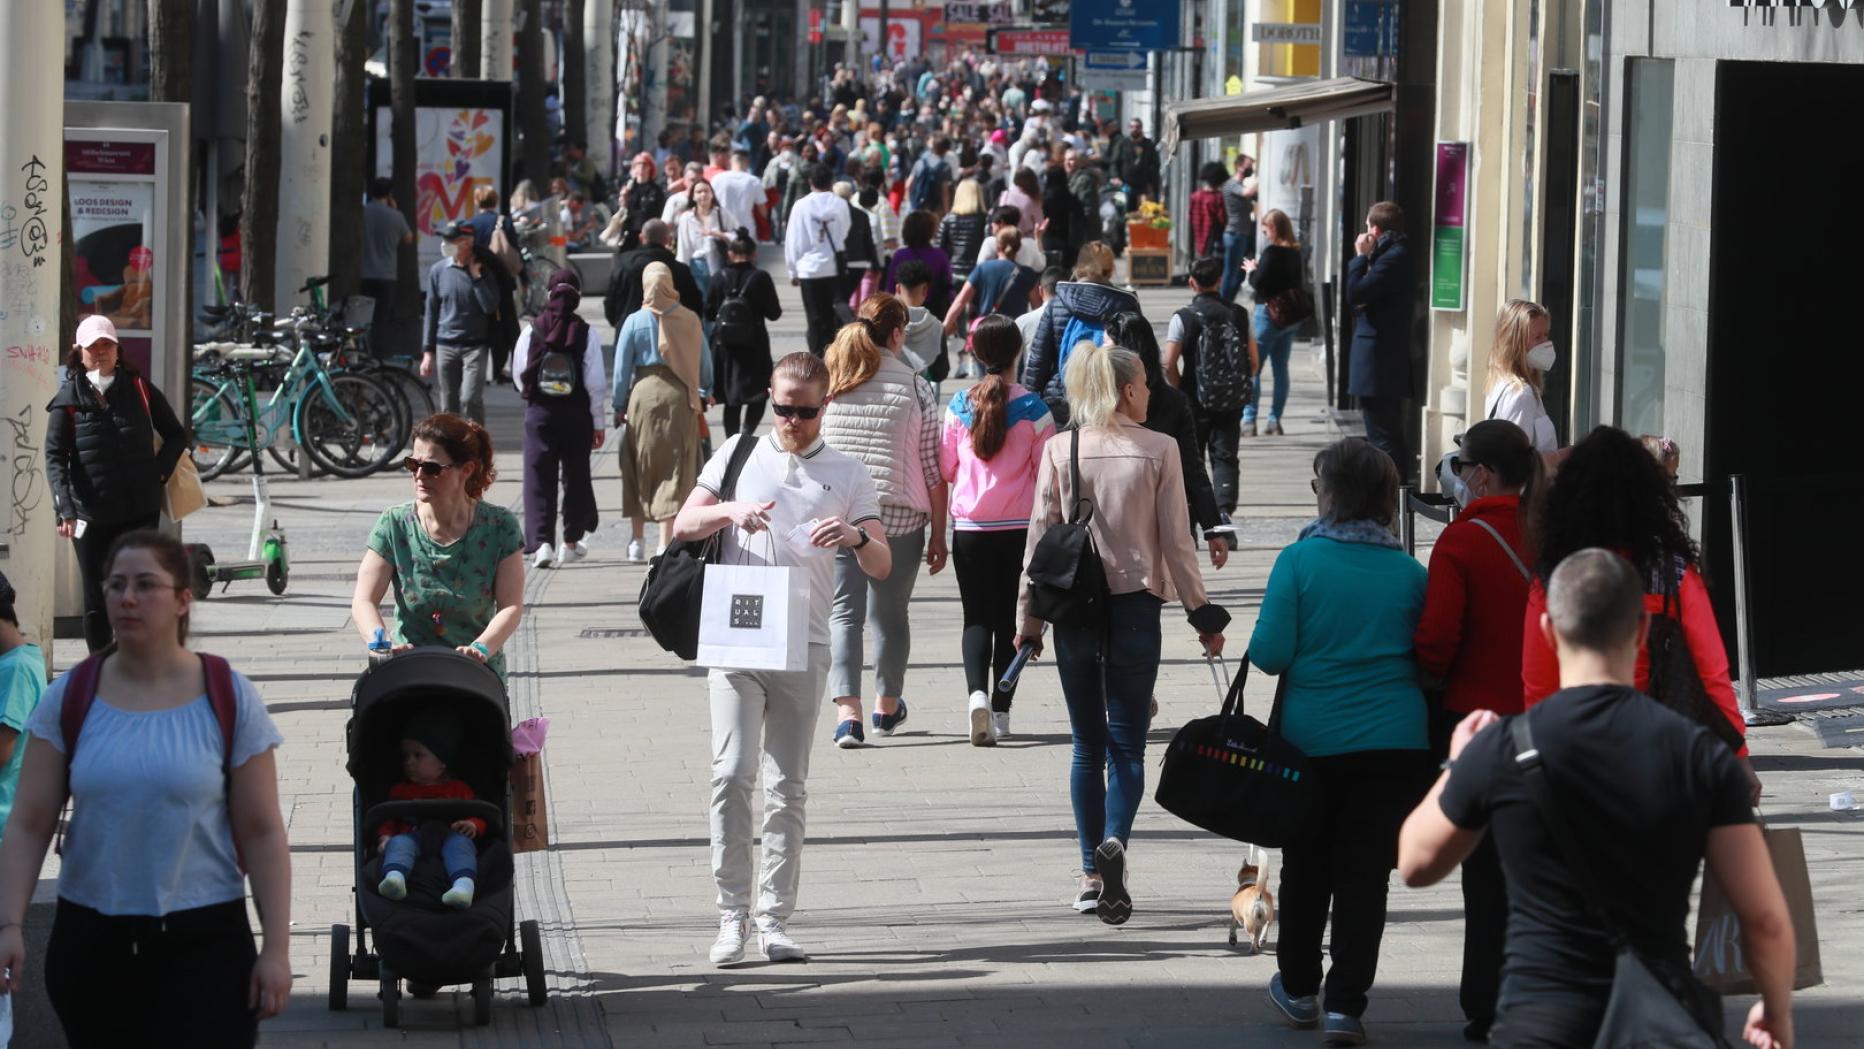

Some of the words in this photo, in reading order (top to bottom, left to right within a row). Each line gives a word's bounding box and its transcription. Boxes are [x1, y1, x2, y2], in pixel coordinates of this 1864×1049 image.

[948, 4, 979, 22] SALE
[988, 4, 1012, 23] SAL
[74, 198, 98, 206] LOOS
[99, 199, 133, 207] DESIGN
[85, 207, 129, 216] REDESIGN
